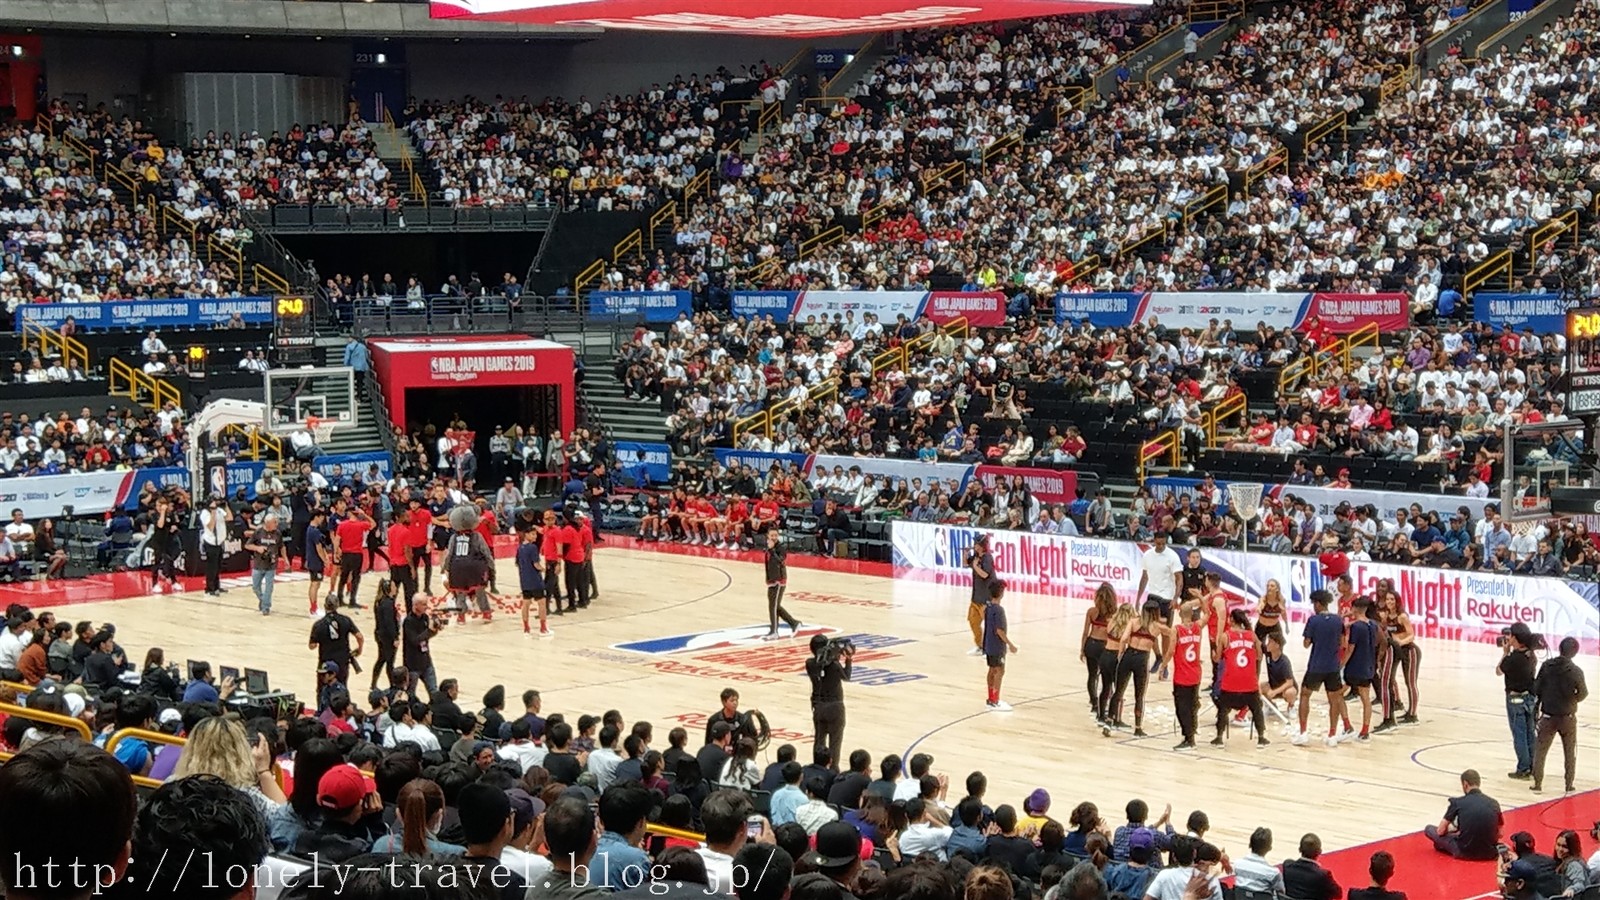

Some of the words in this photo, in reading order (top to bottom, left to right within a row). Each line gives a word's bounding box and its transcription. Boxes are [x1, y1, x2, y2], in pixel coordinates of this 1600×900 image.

[816, 54, 834, 63] 232
[1339, 301, 1360, 314] JAPAN
[1361, 300, 1382, 314] GAMES
[1384, 299, 1400, 314] 2019
[1512, 300, 1535, 315] JAPAN
[1536, 300, 1560, 315] GAMES
[439, 357, 457, 372] NBA
[458, 356, 485, 372] JAPAN
[486, 356, 513, 371] GAMES
[514, 355, 535, 371] 2019
[235, 468, 253, 484] 2019
[1047, 477, 1064, 495] 2019
[456, 542, 469, 556] 00
[1070, 540, 1100, 557] Presented
[1101, 544, 1109, 560] by
[1020, 535, 1067, 586] Night
[1071, 559, 1131, 582] Rakuten
[1467, 576, 1506, 597] Presented
[1506, 579, 1516, 600] by
[1400, 569, 1462, 628] Night
[1467, 598, 1544, 624] Rakuten
[1185, 643, 1197, 662] 6
[1236, 648, 1249, 668] 6
[642, 660, 783, 684] Rakuten
